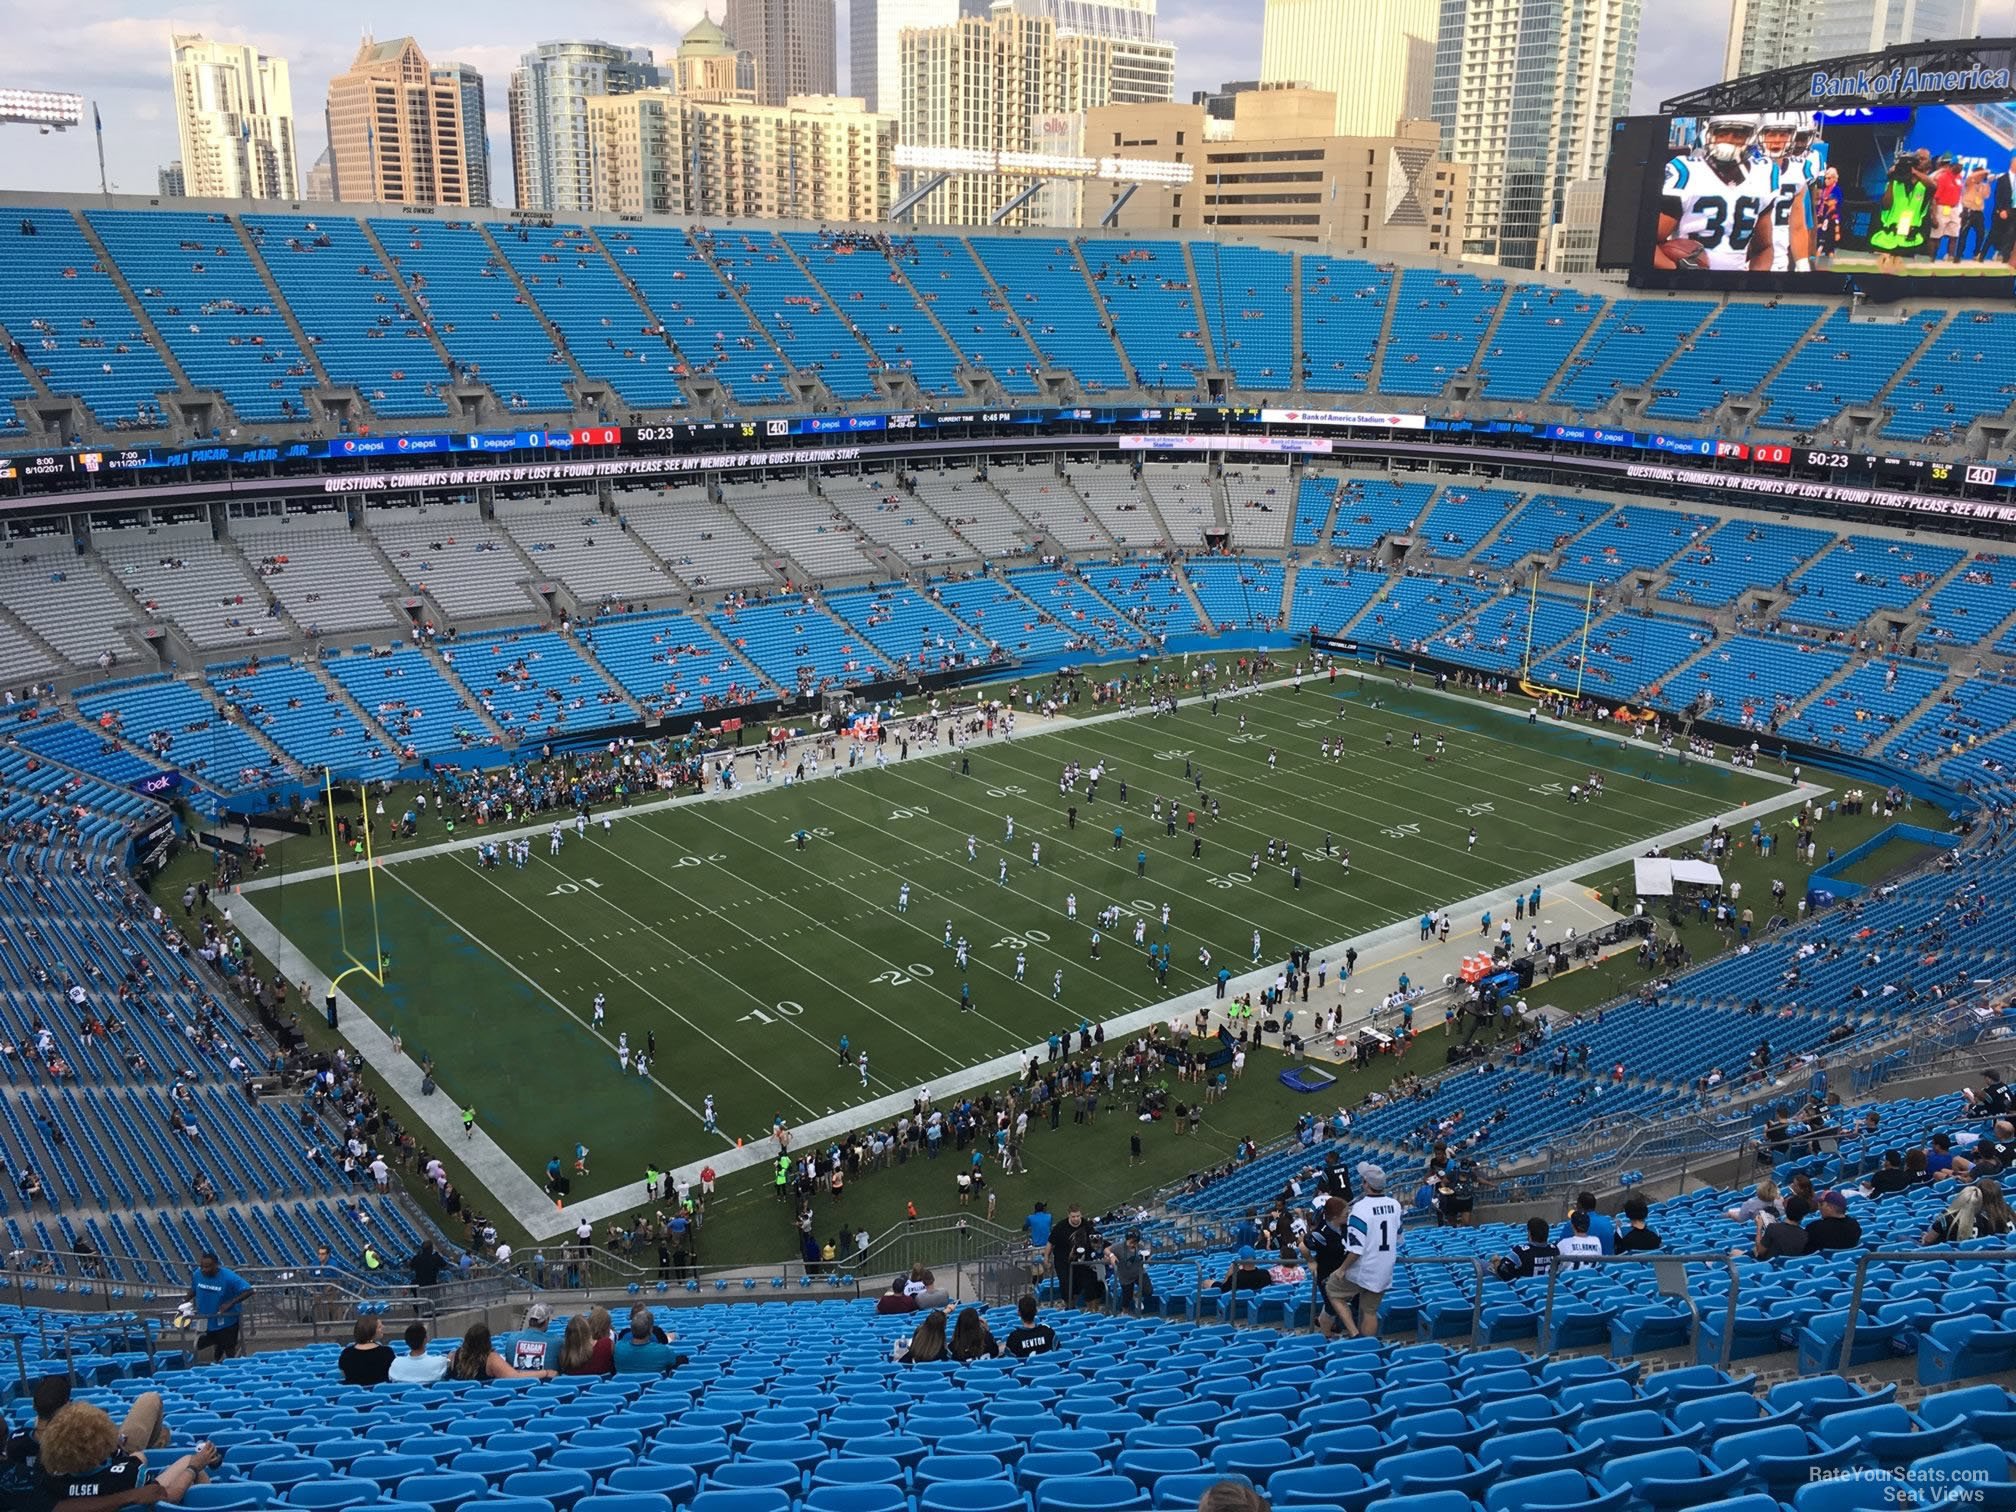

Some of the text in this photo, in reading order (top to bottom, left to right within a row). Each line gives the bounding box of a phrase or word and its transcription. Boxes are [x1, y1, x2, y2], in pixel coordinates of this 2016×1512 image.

[1810, 63, 2010, 97] Bank of America
[982, 413, 997, 421] 6:45
[999, 413, 1010, 421] PM
[1327, 414, 1356, 422] America
[1357, 415, 1384, 423] Stadium
[770, 423, 786, 433] 40
[822, 420, 840, 429] pepsi
[858, 419, 876, 428] pepsi
[582, 432, 590, 443] 0
[605, 431, 613, 443] 0
[637, 427, 674, 441] 50:23
[742, 427, 754, 436] 35
[1565, 430, 1584, 439] pepsi
[411, 439, 437, 449] pepsi
[529, 434, 538, 446] 0
[1603, 434, 1623, 443] pepsi
[358, 441, 384, 452] pepsi
[36, 457, 54, 465] 8:00
[109, 459, 146, 468] 8/11/2017
[1808, 452, 1848, 468] 50:23
[25, 465, 63, 475] 8/10/2017
[325, 448, 860, 492] QUESTIONS, COMMENTS OR REPORTS OF LOST & FOUND ITEMS? PLEASE SEE ANY MEMBER OF OUR GUEST RELATIONS STAFF.
[1932, 468, 1948, 480] 35
[1971, 470, 1991, 482] 40
[1626, 465, 1674, 482] QUESTIONS,
[1676, 471, 1725, 487] COMMENTS
[1727, 476, 1740, 488] OR
[1741, 478, 1783, 493] REPORTS
[1785, 483, 1798, 494] OF
[1800, 485, 1823, 498] LOST
[1824, 488, 1833, 498] &
[1835, 489, 1872, 504] FOUND
[1871, 493, 1907, 508] ITEMS?
[1909, 496, 1949, 512] PLEASE
[1950, 502, 1971, 515] SEE
[1973, 505, 1999, 519] ANY
[1206, 872, 1252, 890] 50
[1000, 929, 1051, 951] 30
[880, 963, 934, 986] 20
[750, 1000, 804, 1025] 10
[1339, 1174, 1346, 1189] 1
[1372, 1205, 1394, 1216] NEWTON
[1379, 1220, 1390, 1251] 1
[1022, 1336, 1045, 1349] NEWTON
[69, 1484, 99, 1496] OLSEN
